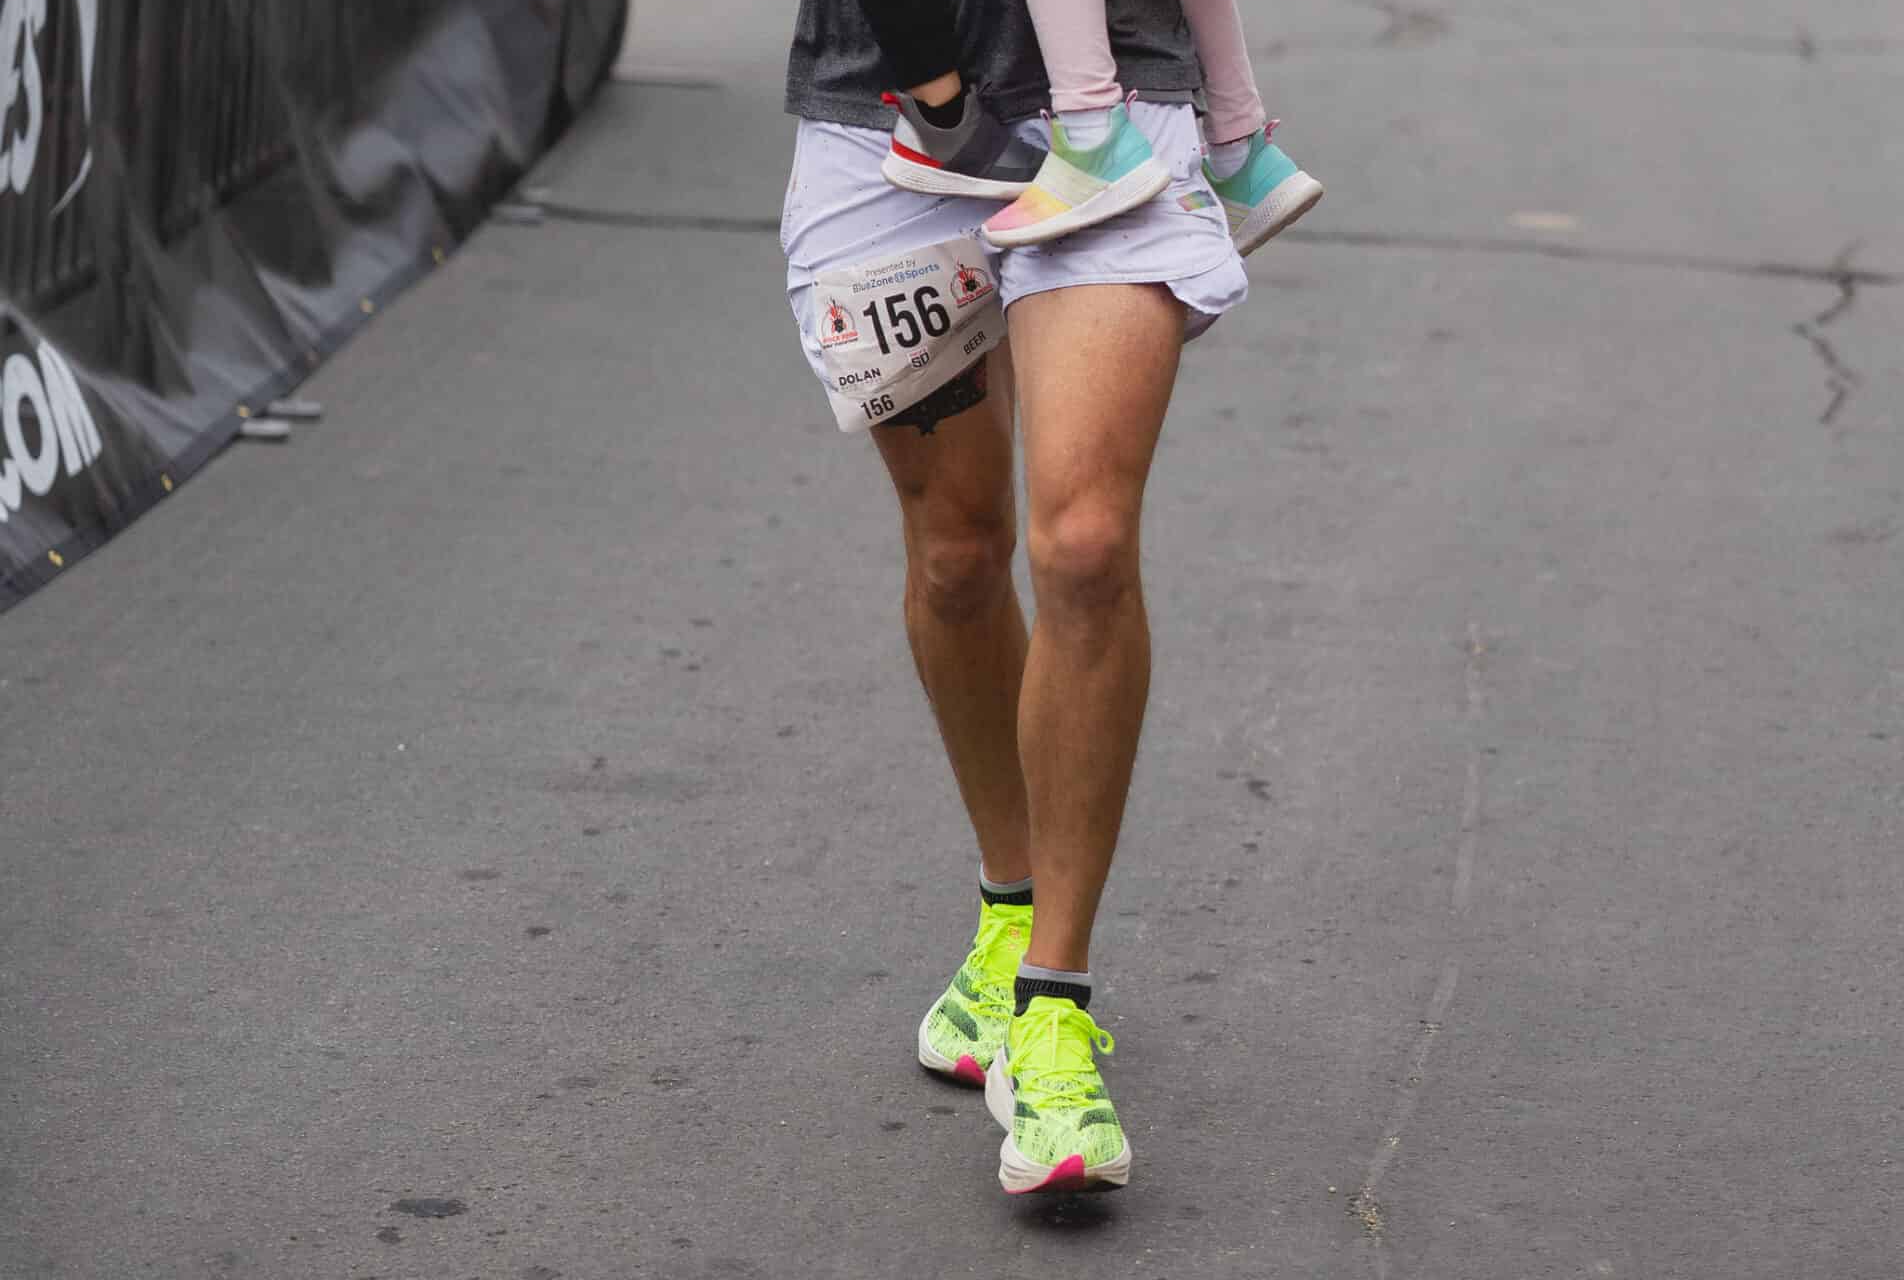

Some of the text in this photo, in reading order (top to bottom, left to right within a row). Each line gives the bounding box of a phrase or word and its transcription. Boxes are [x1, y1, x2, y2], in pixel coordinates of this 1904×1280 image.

[865, 258, 917, 277] Presented by
[863, 285, 951, 355] 156
[963, 330, 987, 355] BEER
[838, 367, 882, 386] DOLAN
[861, 394, 895, 420] 156
